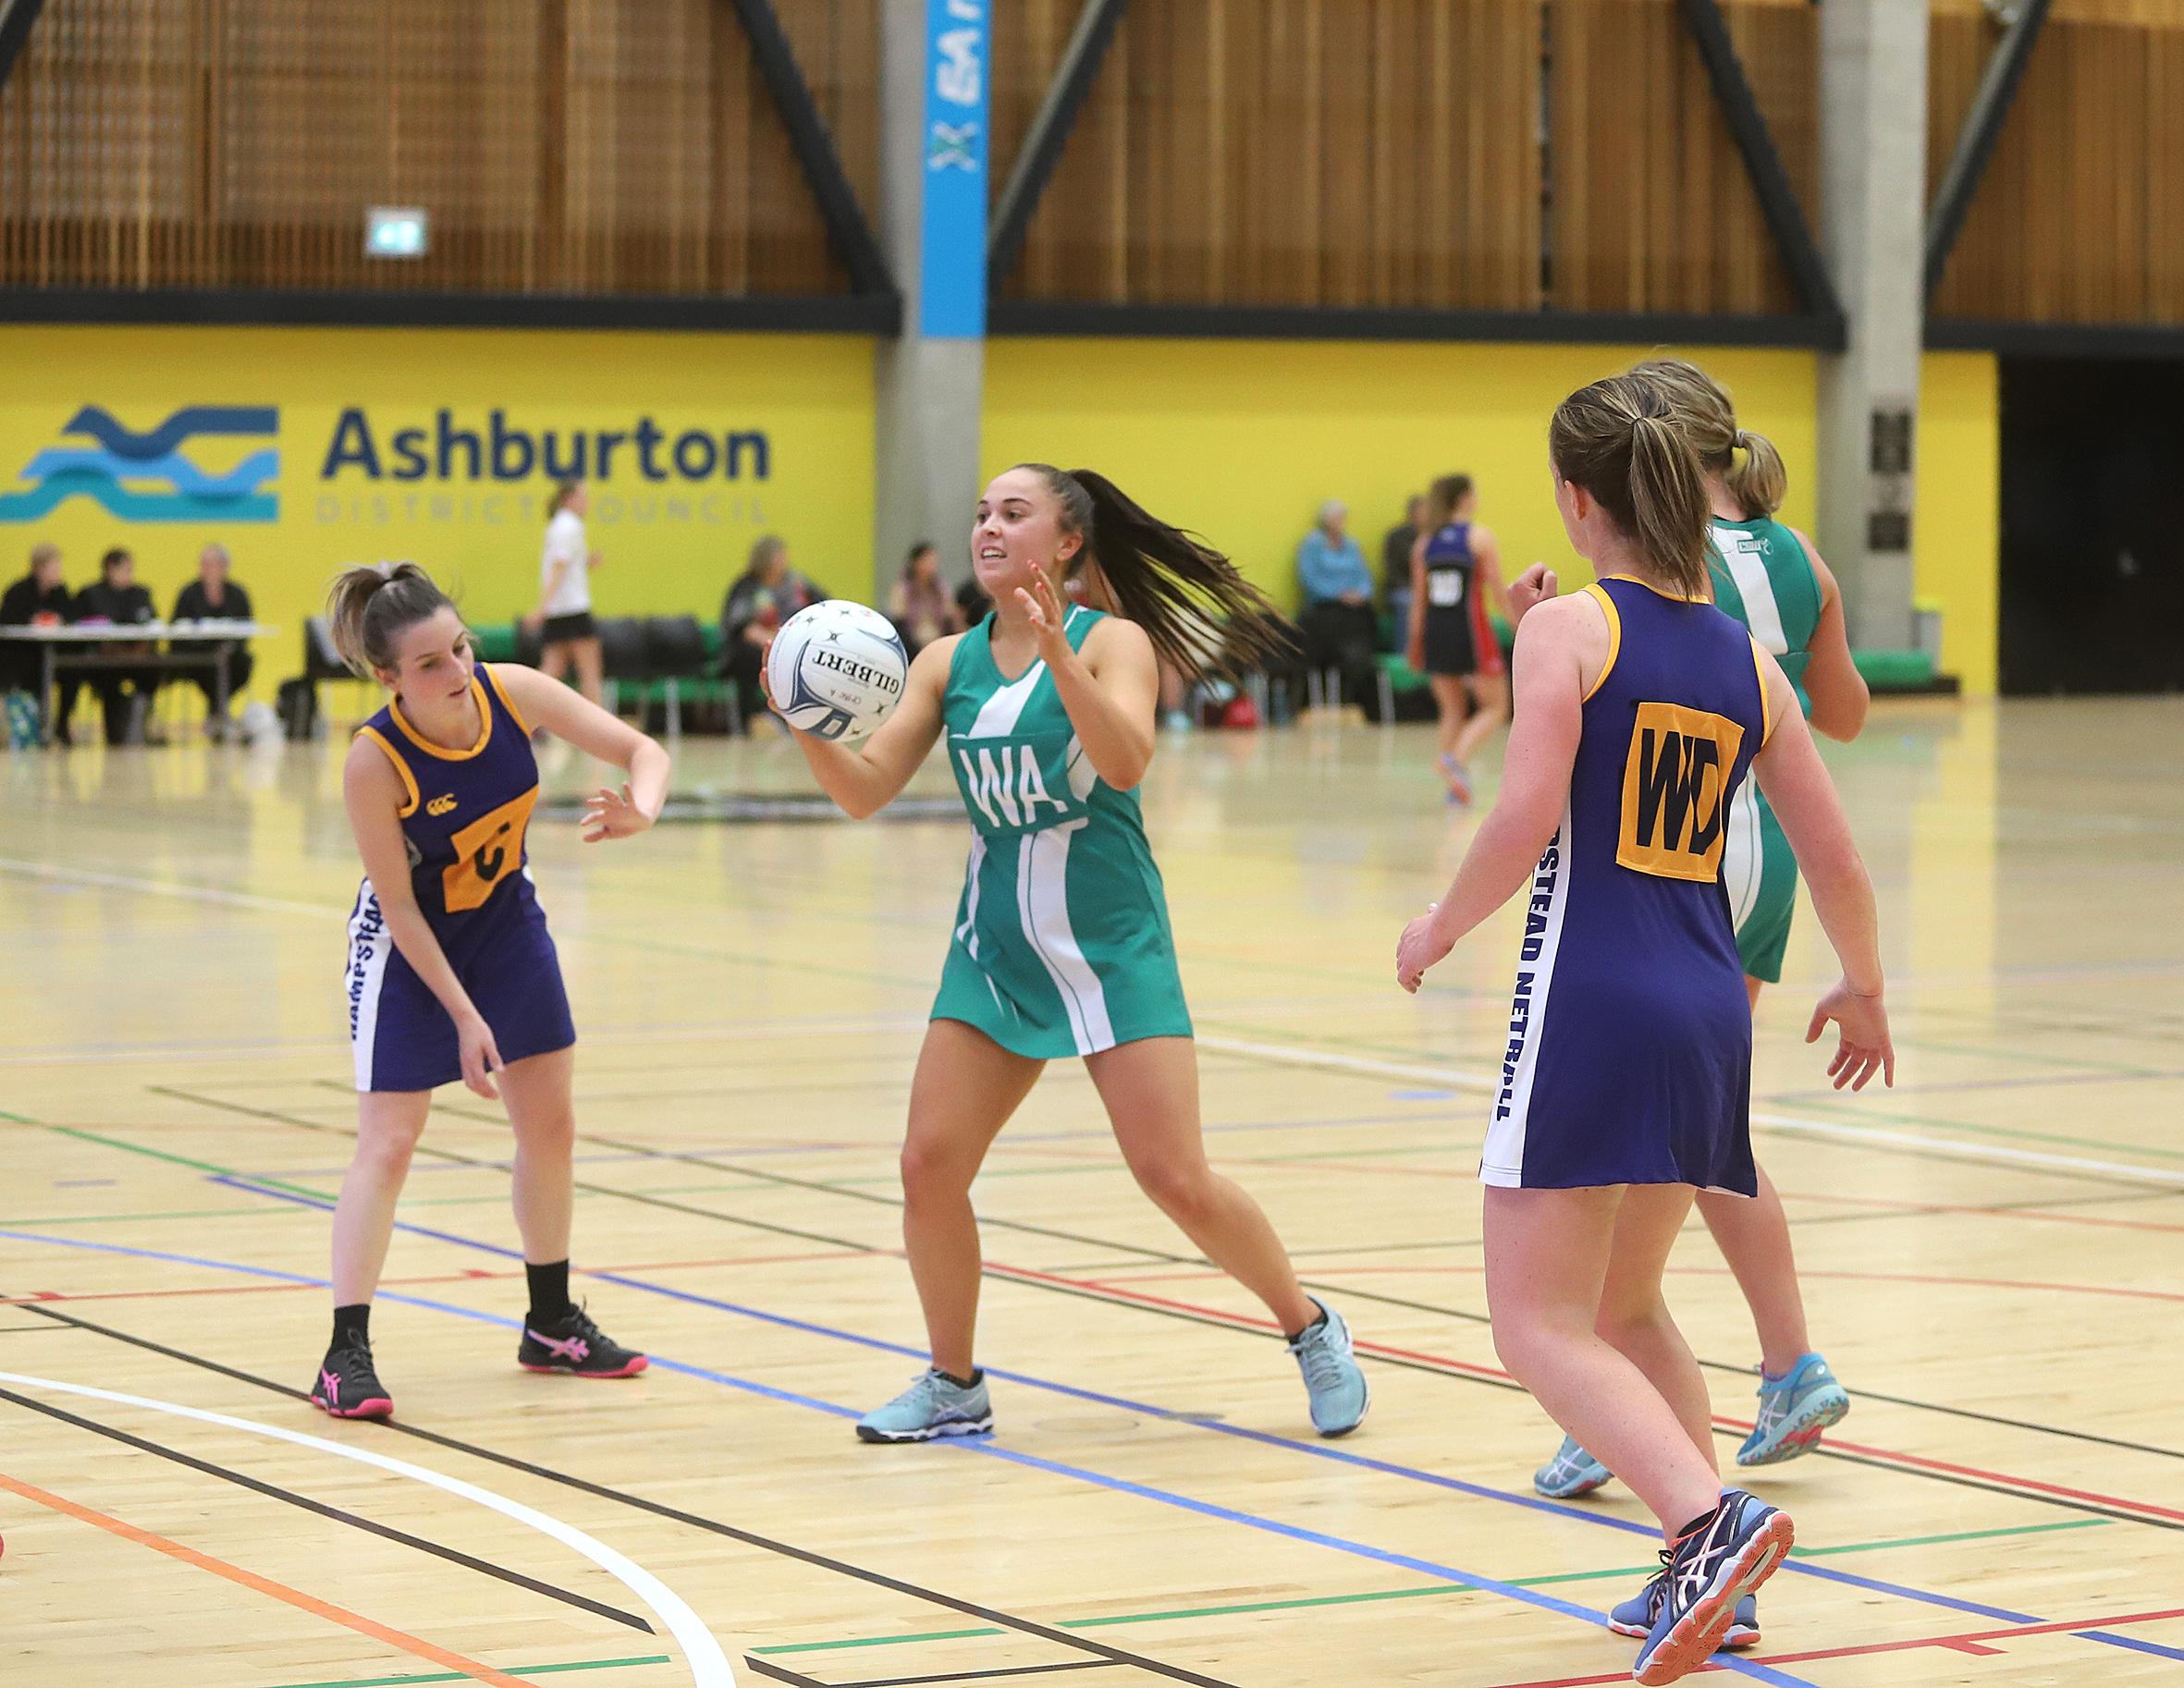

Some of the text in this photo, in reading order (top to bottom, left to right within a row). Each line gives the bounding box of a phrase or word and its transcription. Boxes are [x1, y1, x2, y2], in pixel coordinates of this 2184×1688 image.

[320, 407, 771, 482] Ashburton
[314, 494, 770, 525] DISTRICT OUNCIL
[812, 649, 900, 695] GILBERT
[959, 744, 1068, 828] WA
[1636, 728, 1721, 855] WD
[1496, 972, 1535, 1121] NETBALL
